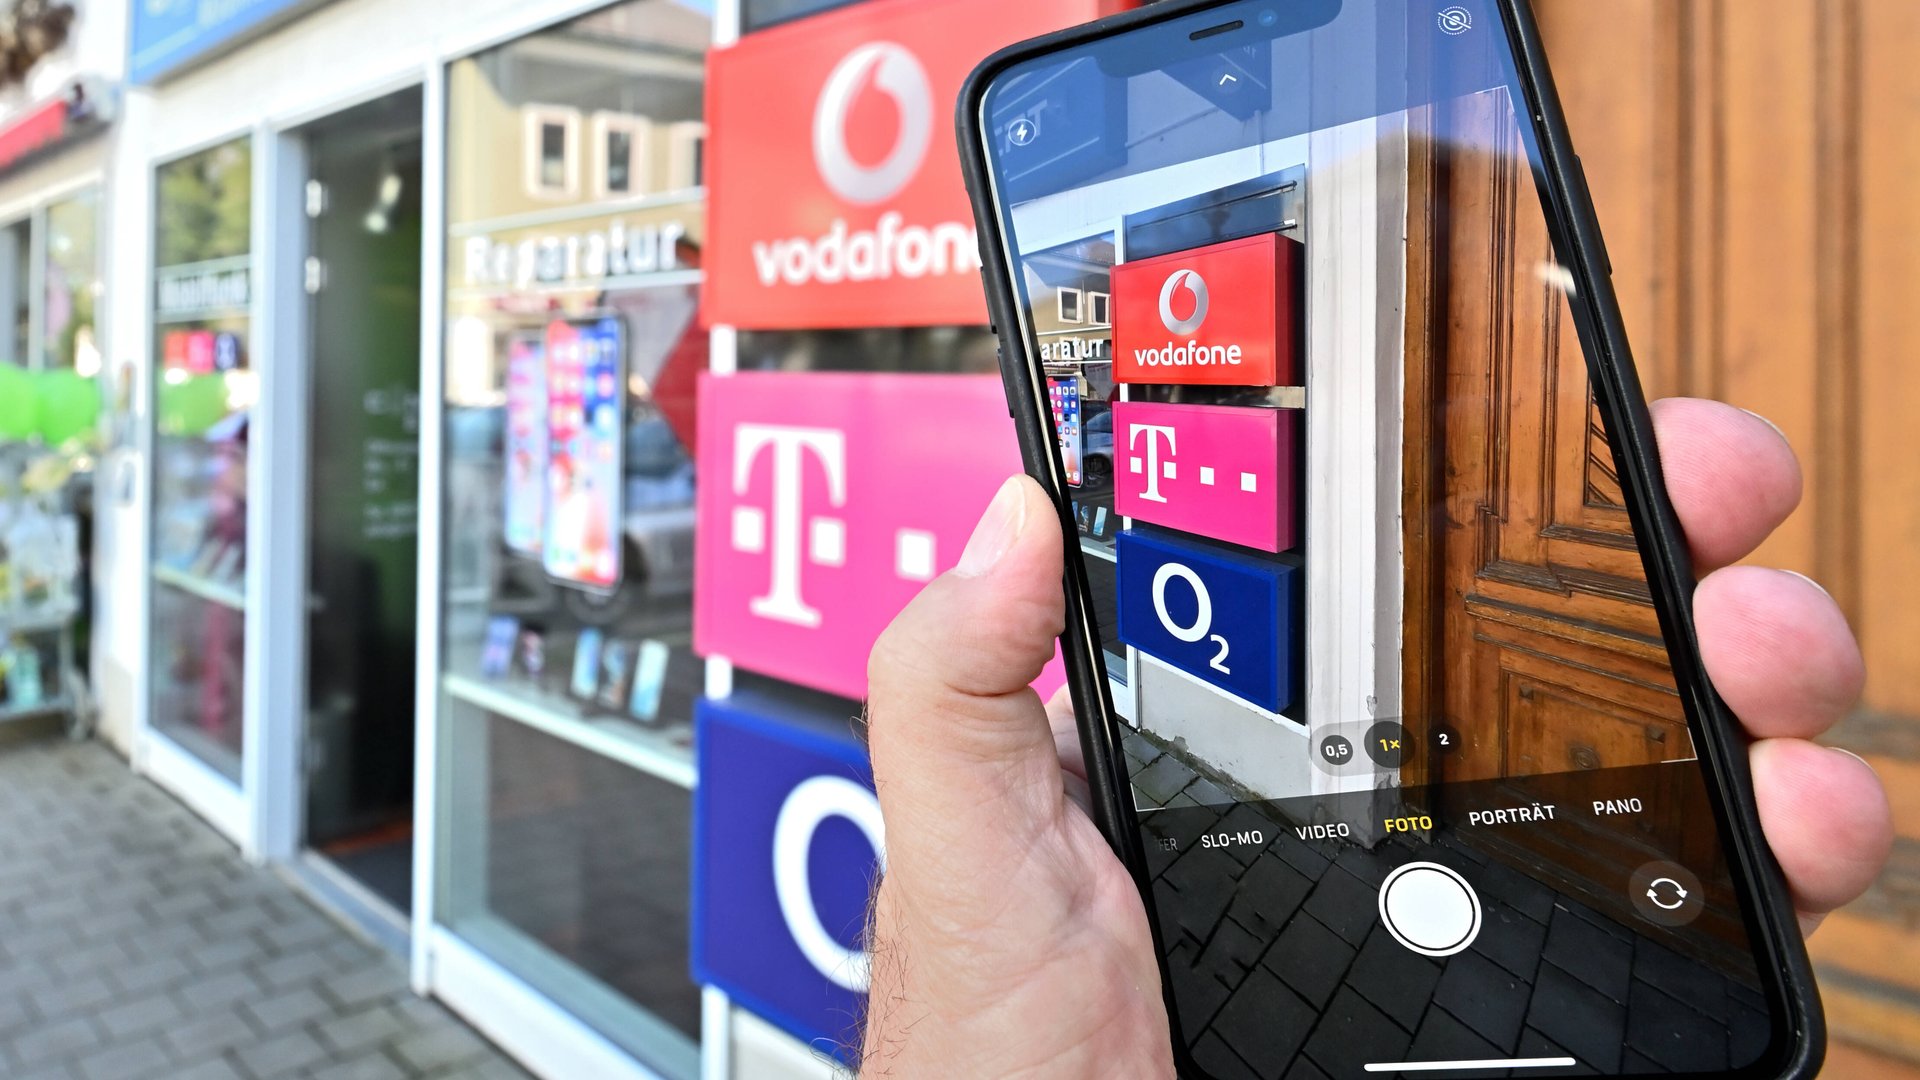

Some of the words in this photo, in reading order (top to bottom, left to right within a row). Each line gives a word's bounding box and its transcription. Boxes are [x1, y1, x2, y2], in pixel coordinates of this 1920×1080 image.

[465, 217, 684, 292] Reparatur
[1134, 340, 1243, 367] vodafone
[1129, 423, 1177, 503] T
[732, 422, 846, 629] T
[1152, 562, 1231, 675] O2
[1325, 743, 1348, 759] 0,5
[1438, 733, 1450, 746] 2
[1201, 830, 1264, 849] SLO-MO
[1295, 822, 1350, 841] VIDEO
[1384, 815, 1433, 834] FOTO
[1468, 802, 1555, 827] PORTRÄT
[1593, 797, 1643, 816] PANO
